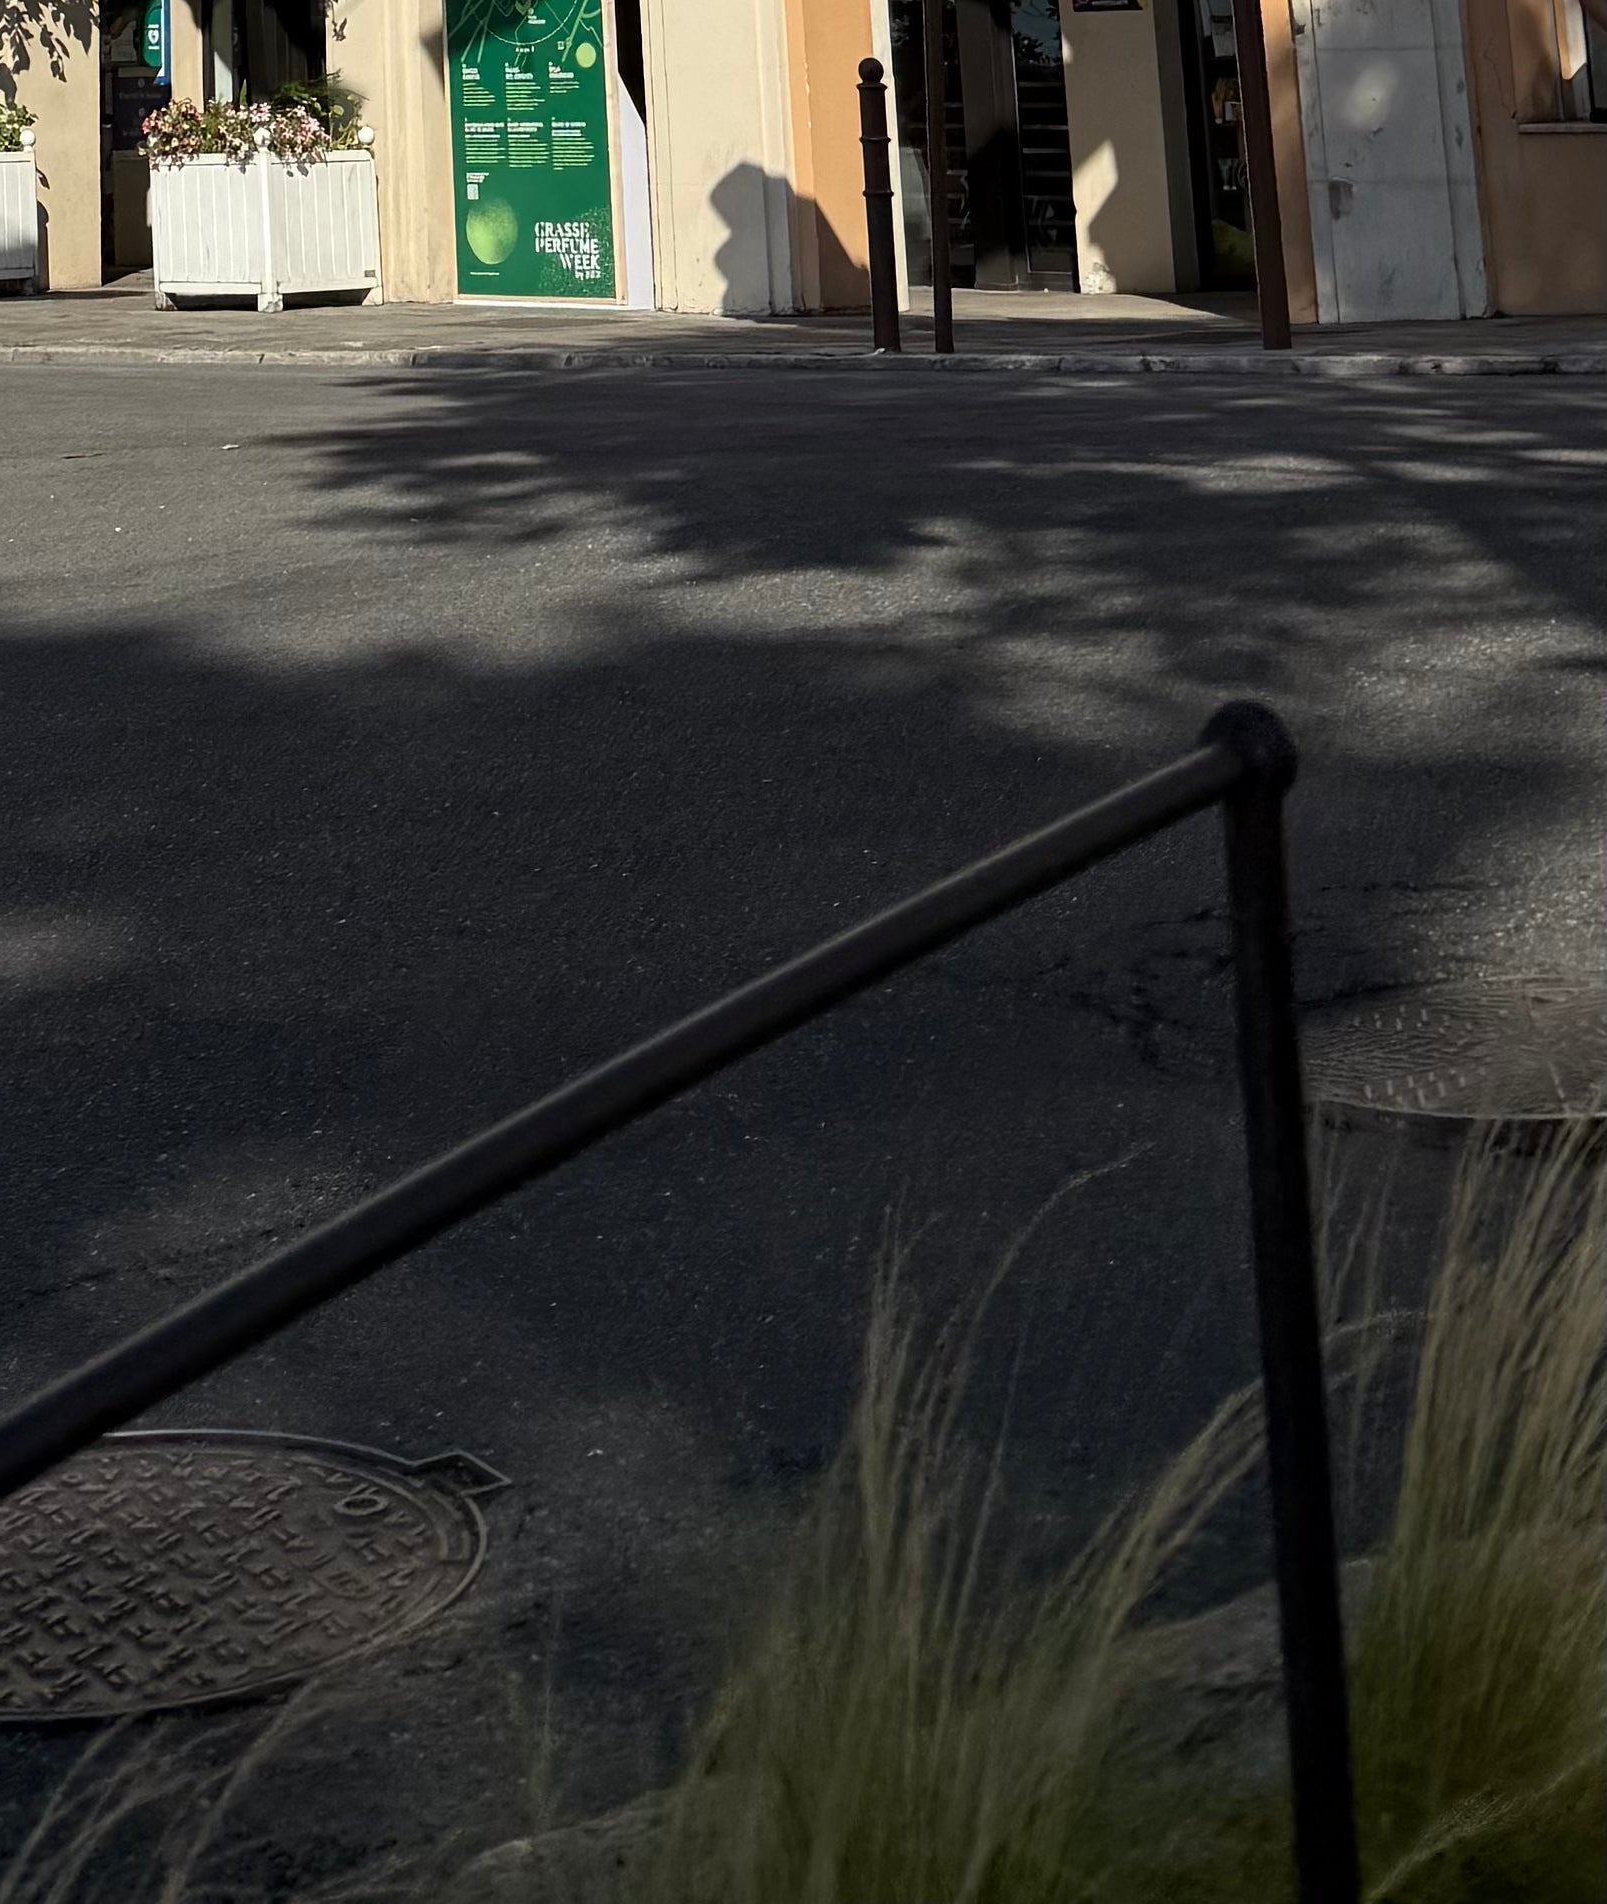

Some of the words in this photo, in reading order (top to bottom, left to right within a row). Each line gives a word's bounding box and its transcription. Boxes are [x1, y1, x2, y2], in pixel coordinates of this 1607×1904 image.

[534, 221, 590, 238] GRASSE
[534, 238, 600, 254] PERFUME
[559, 254, 601, 270] WEEK
